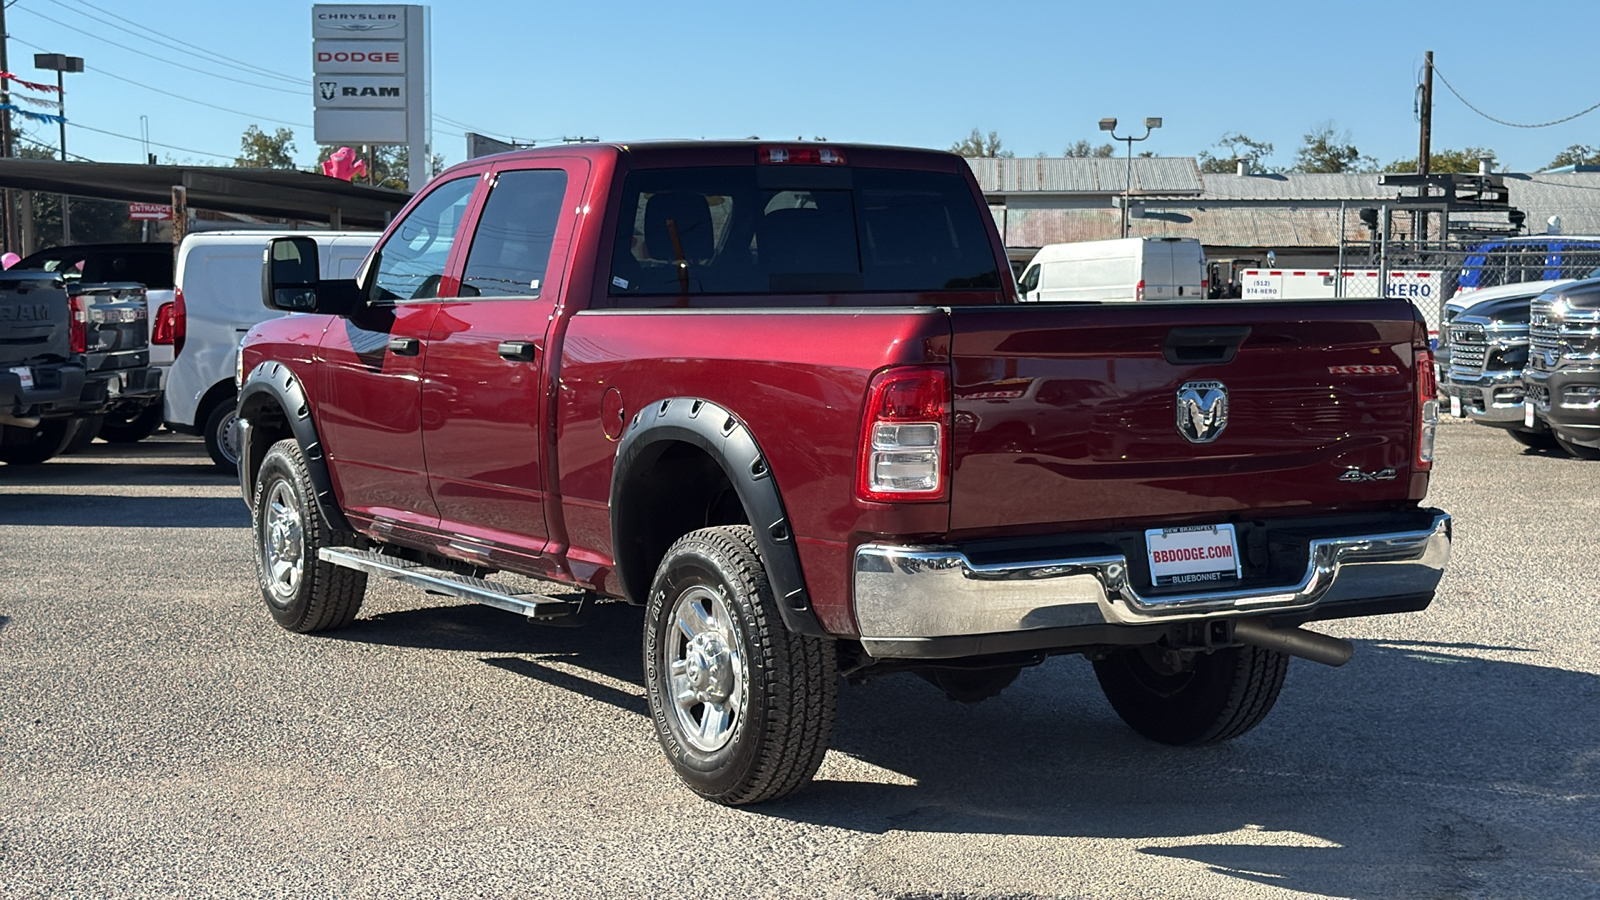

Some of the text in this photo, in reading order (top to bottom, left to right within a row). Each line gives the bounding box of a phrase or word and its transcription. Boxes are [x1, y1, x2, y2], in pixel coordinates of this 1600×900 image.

[317, 52, 400, 62] DODGE
[342, 87, 400, 97] RAM
[129, 204, 171, 212] ENTRANCE
[1386, 284, 1431, 297] HERO
[1153, 545, 1233, 563] BBDODGE.COM
[1172, 572, 1221, 583] BLUEBONNET
[647, 625, 681, 757] TRANSFORCE
